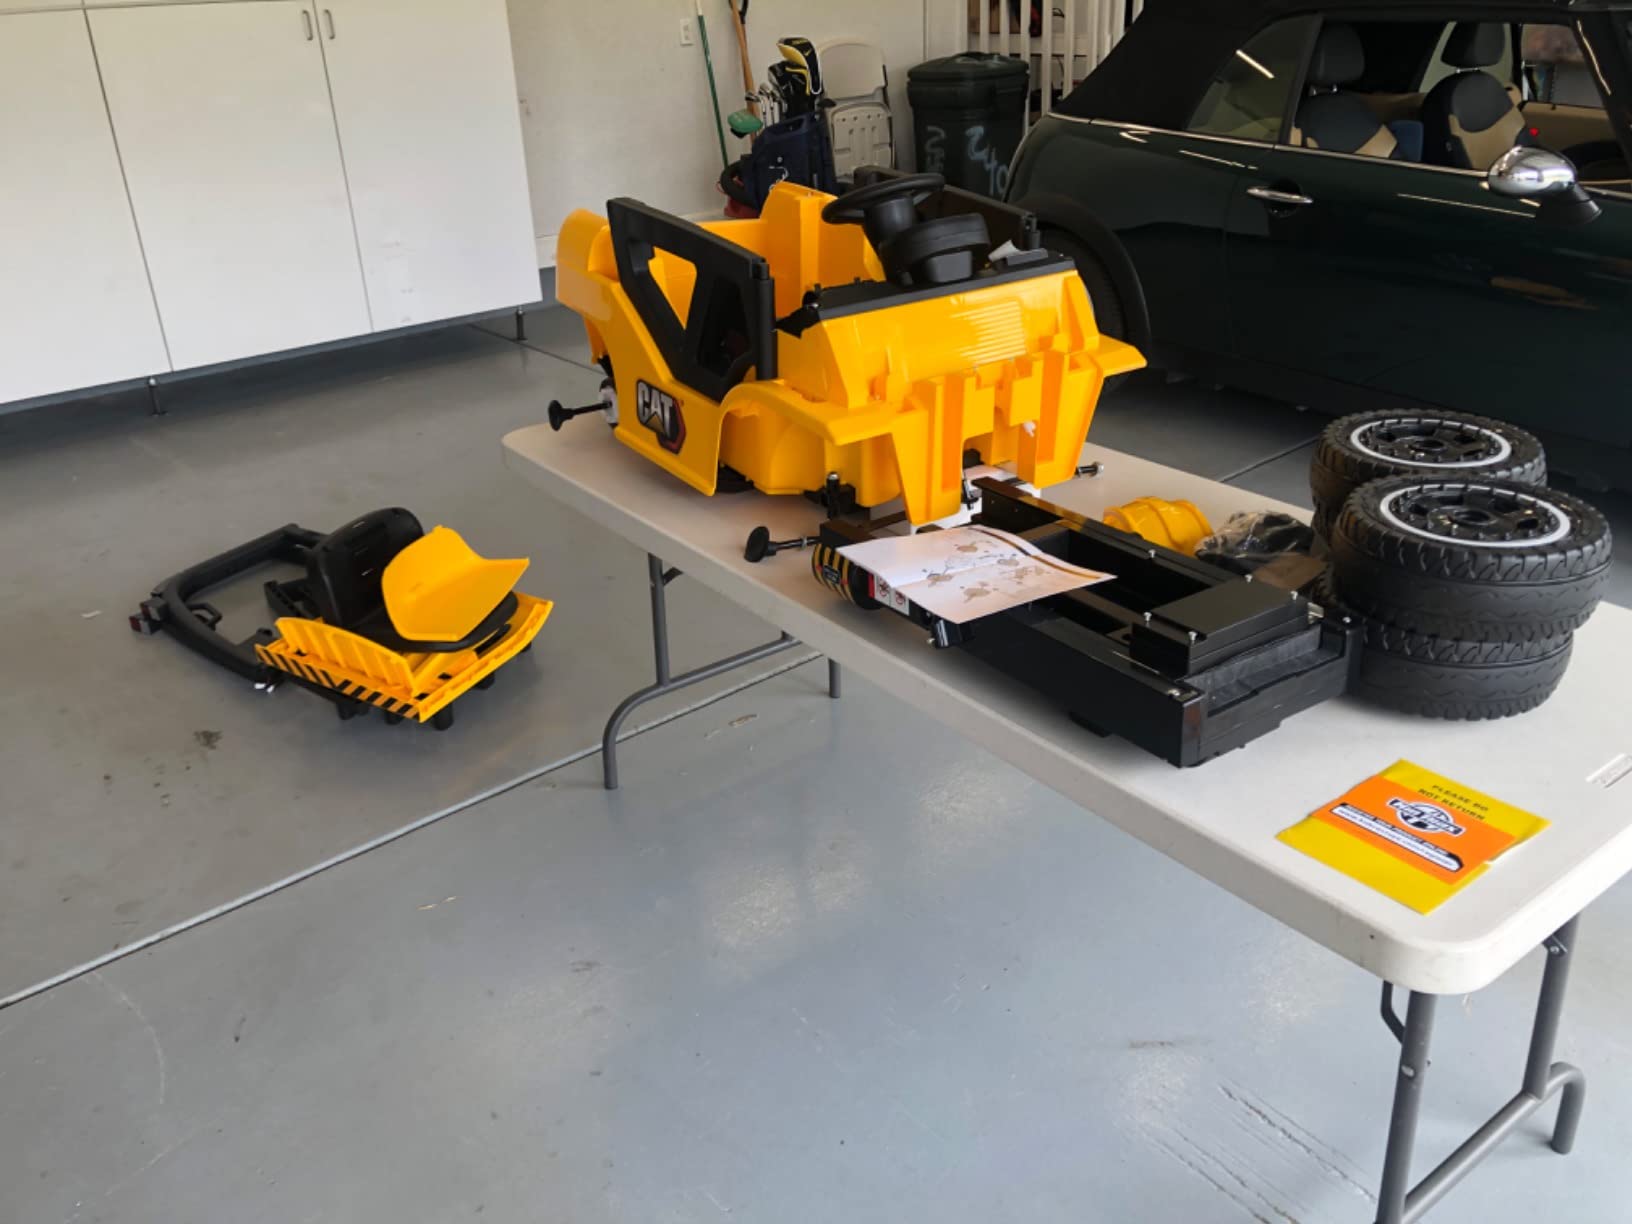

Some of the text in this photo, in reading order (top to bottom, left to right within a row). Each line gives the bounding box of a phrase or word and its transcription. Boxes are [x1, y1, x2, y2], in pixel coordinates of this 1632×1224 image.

[637, 381, 673, 438] CAT
[1418, 788, 1440, 800] NOT
[1441, 799, 1486, 821] RETURN
[1431, 784, 1472, 804] PLEASE
